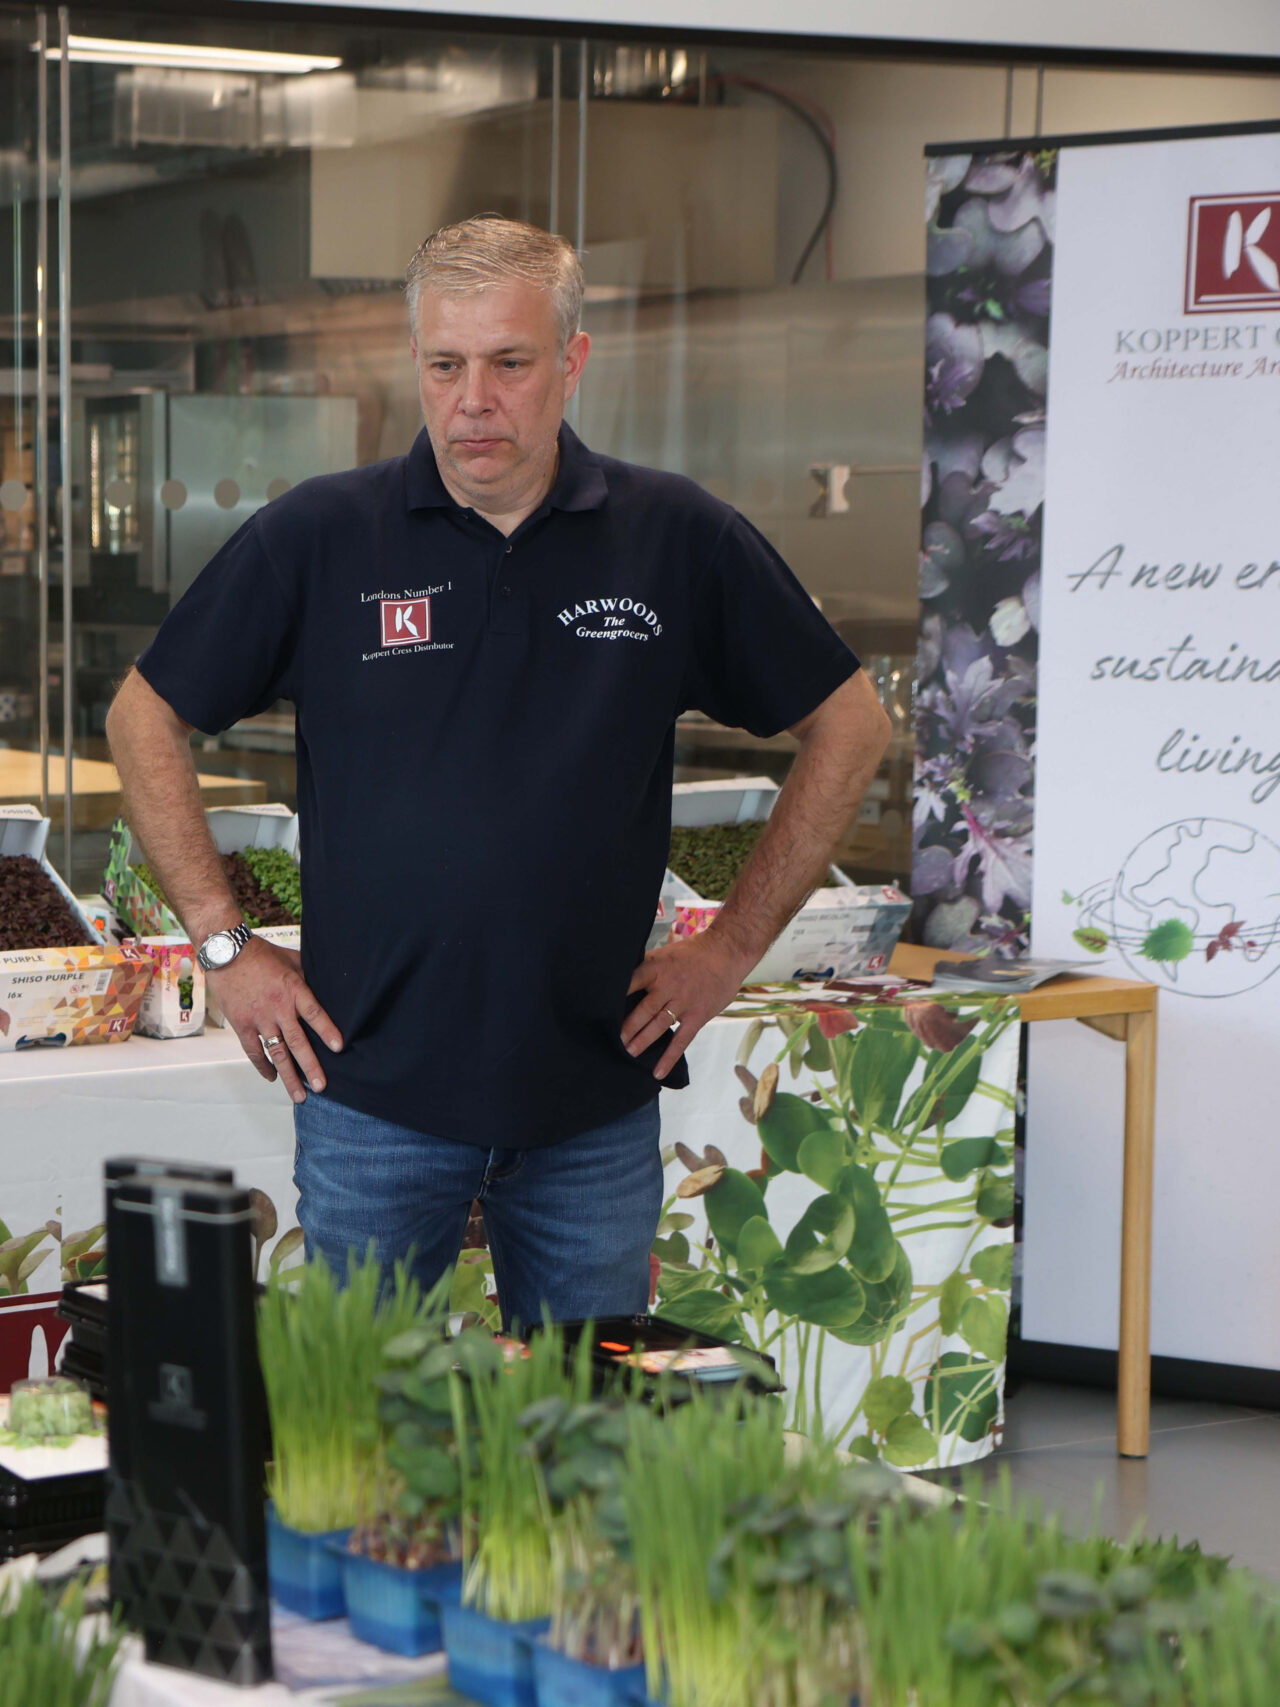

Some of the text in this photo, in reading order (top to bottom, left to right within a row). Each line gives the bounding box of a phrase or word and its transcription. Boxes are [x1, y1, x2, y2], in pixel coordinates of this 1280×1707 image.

[1115, 325, 1266, 354] KOPPERT
[1106, 357, 1243, 384] Architecture
[1067, 543, 1125, 593] A
[1130, 561, 1223, 590] new
[360, 590, 401, 603] Londons
[404, 584, 444, 599] Number
[556, 597, 663, 636] HARWOODS
[603, 616, 626, 627] The
[575, 626, 649, 641] Greengrocers
[362, 642, 455, 661] Koppert Cress Distributor
[4, 954, 45, 965] PURPLE
[11, 972, 86, 985] SHISO PURPLE
